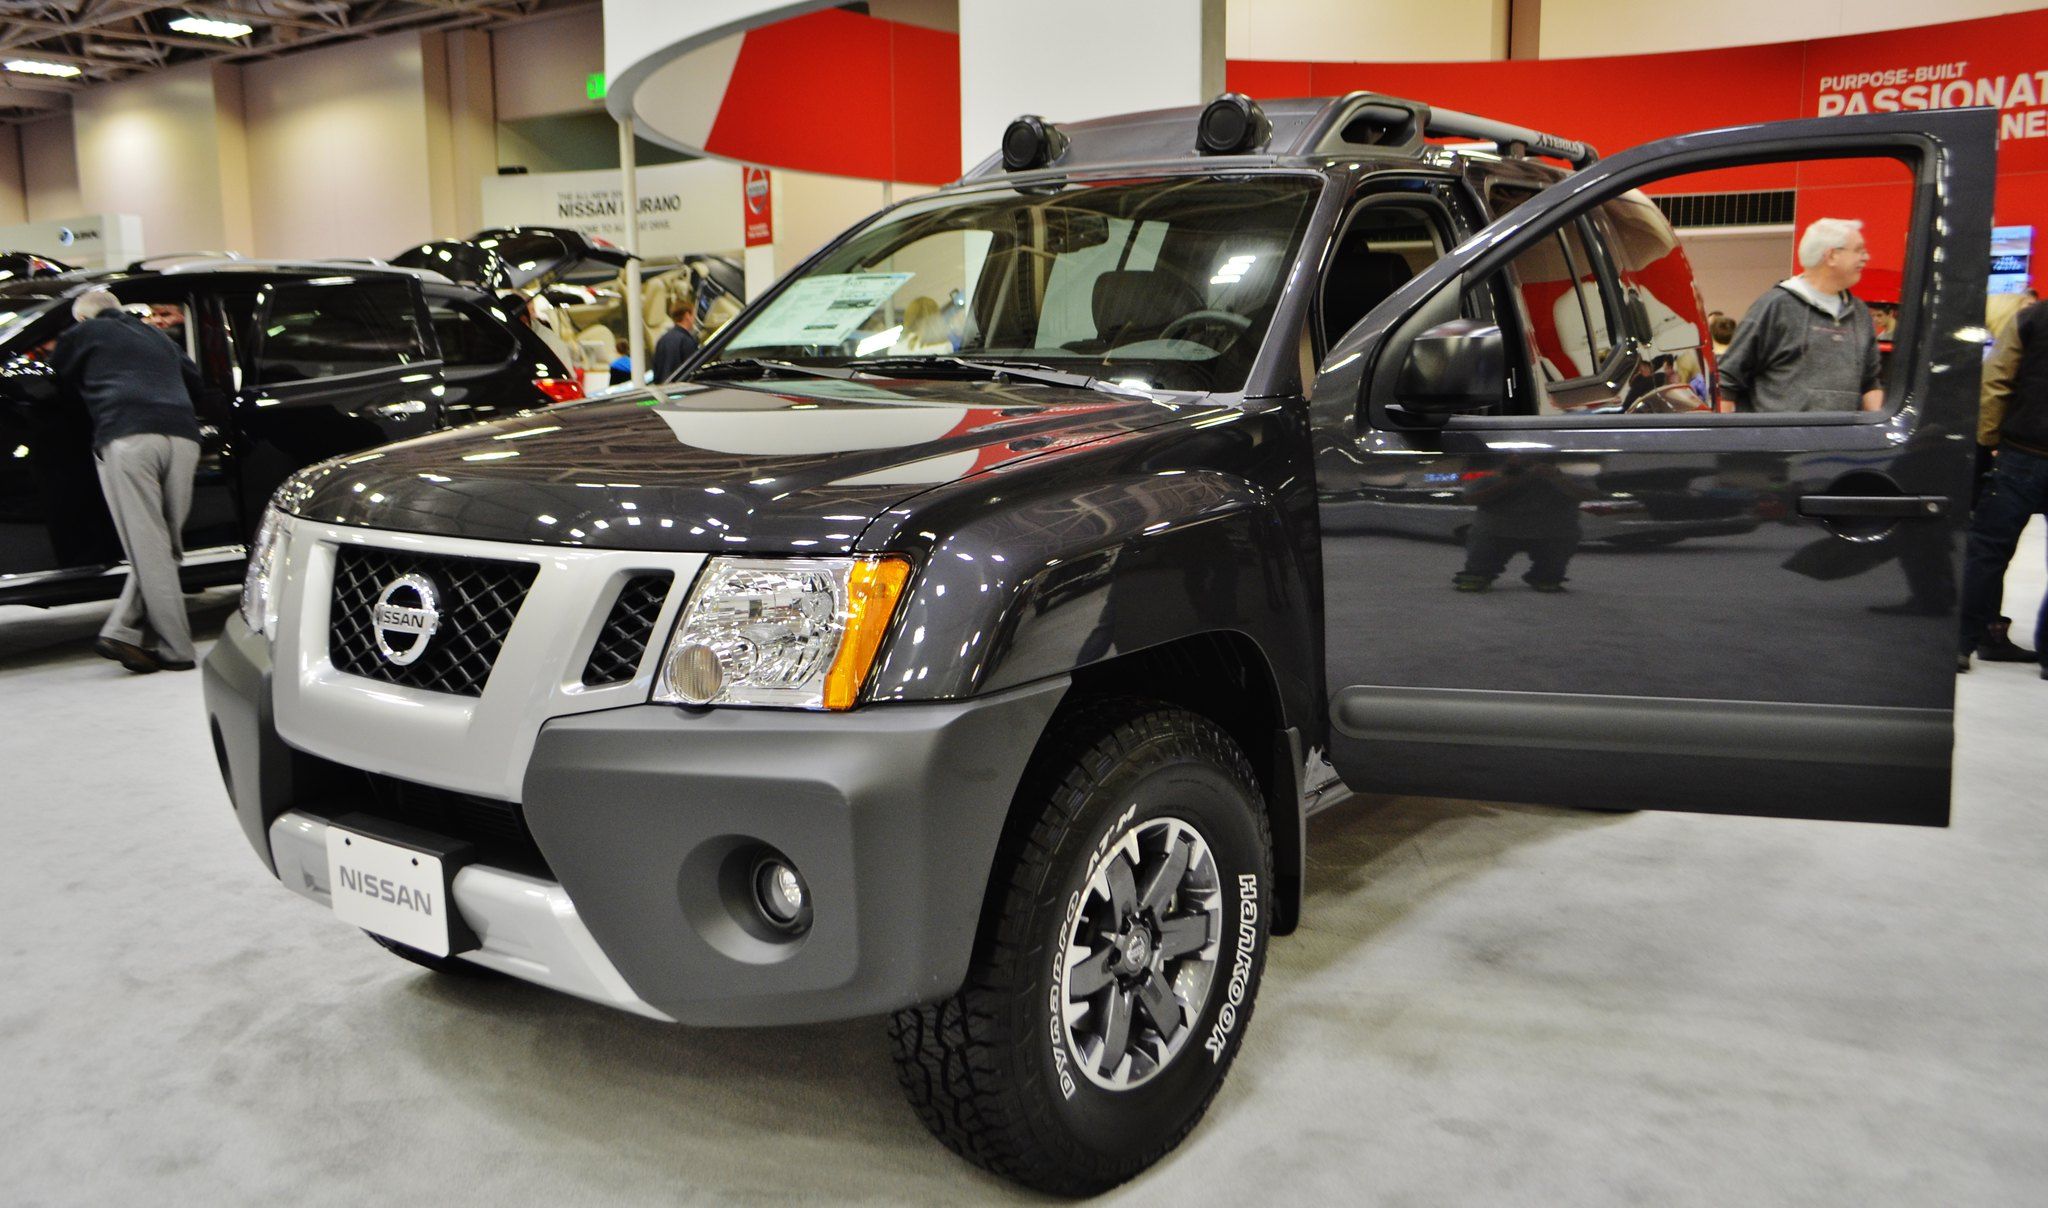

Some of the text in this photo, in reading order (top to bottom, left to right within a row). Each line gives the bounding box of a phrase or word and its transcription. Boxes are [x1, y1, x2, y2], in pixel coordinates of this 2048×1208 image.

[1819, 61, 1968, 93] PURPOSE-BUILT
[558, 194, 681, 218] NISSAN URANO
[377, 609, 425, 629] SSAN
[340, 865, 432, 916] NISSAN
